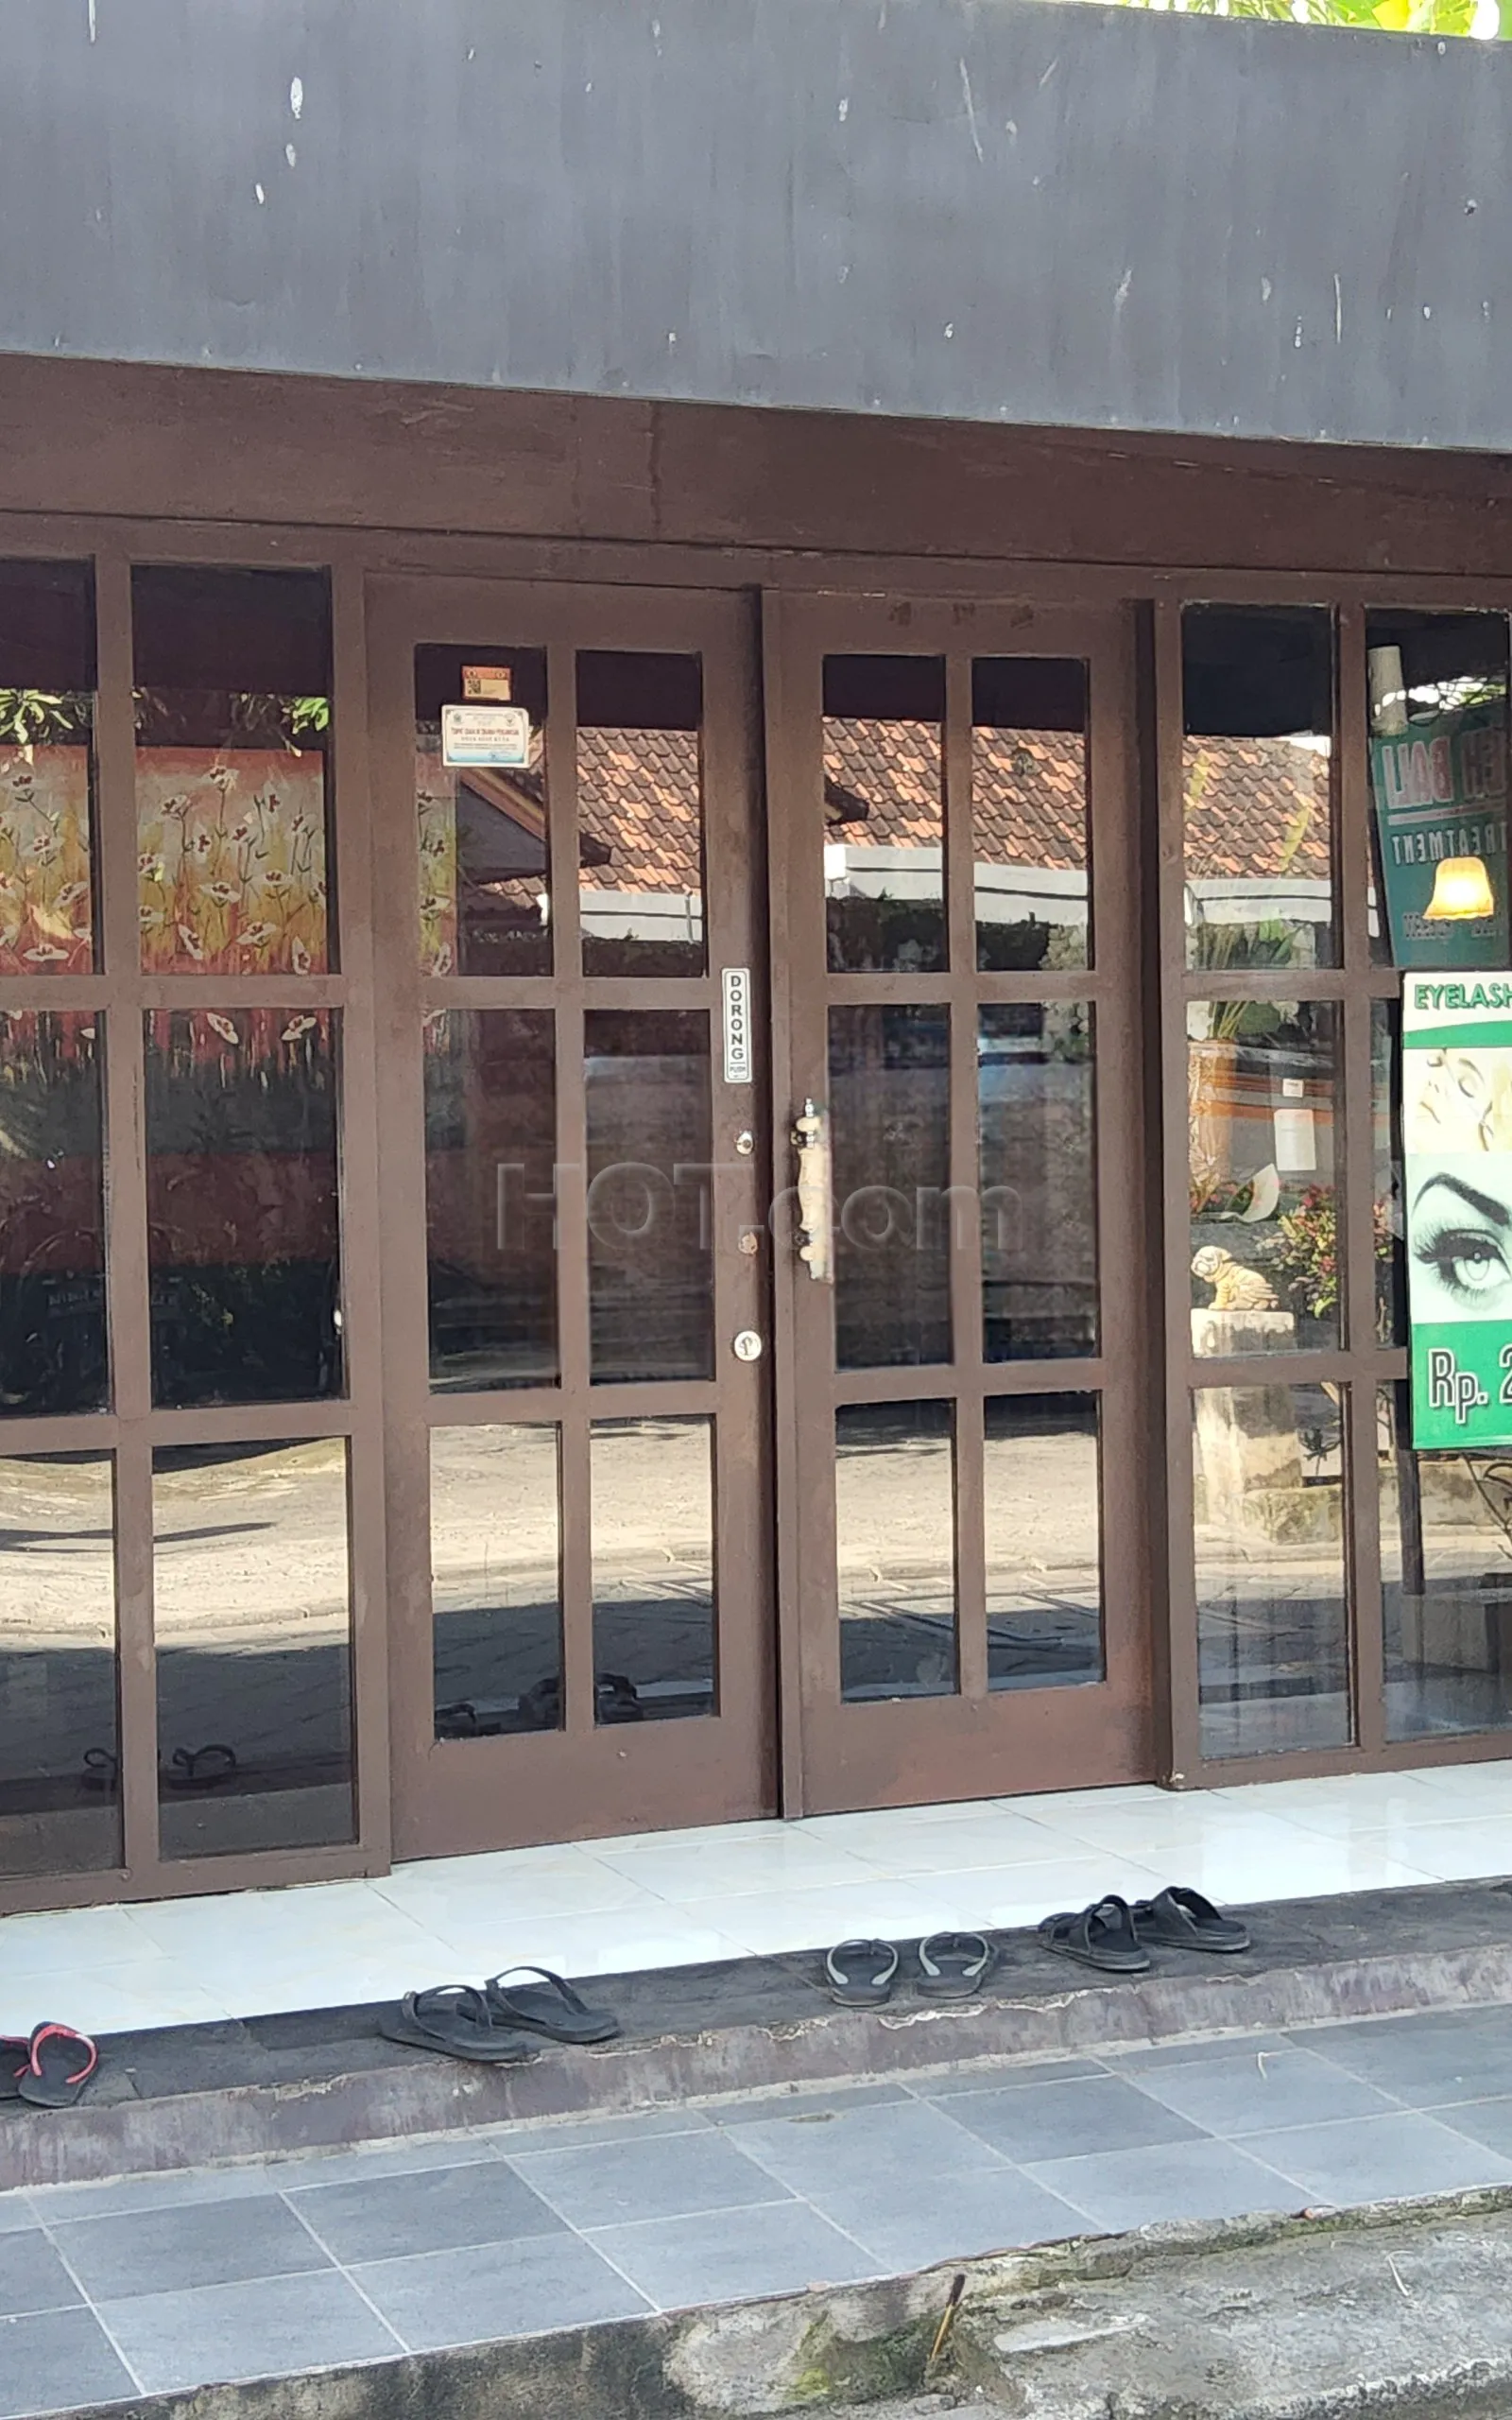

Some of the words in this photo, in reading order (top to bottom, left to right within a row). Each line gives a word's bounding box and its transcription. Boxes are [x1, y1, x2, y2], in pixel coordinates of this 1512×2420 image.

[730, 976, 744, 1060] DORONG
[1415, 983, 1512, 1009] EYELASH
[1428, 1348, 1488, 1425] Rp.
